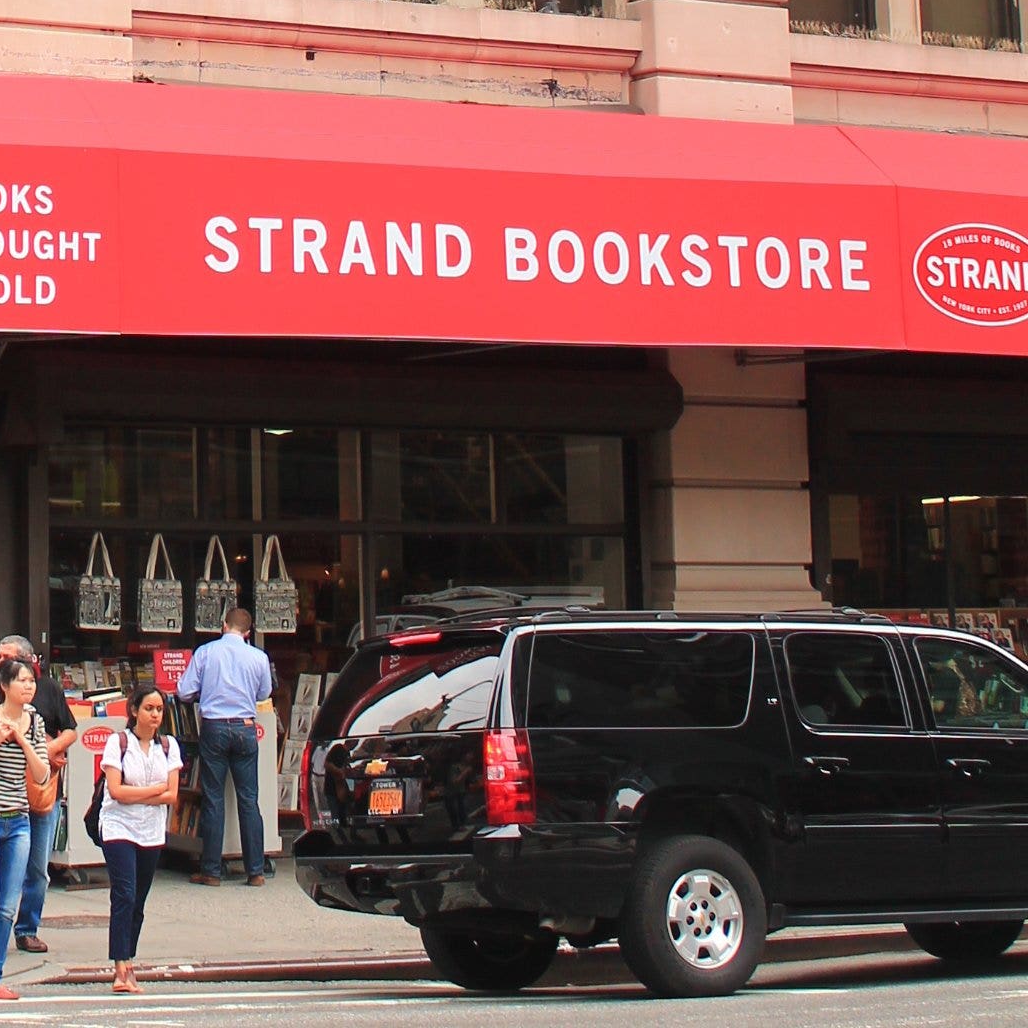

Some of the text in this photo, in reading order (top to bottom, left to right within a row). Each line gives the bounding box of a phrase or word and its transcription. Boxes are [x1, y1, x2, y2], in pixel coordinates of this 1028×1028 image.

[204, 216, 871, 292] STRAND BOOKSTORE
[954, 234, 979, 245] MILES
[981, 235, 992, 243] OF
[994, 237, 1021, 254] BOOKS
[942, 295, 957, 307] NEW
[958, 303, 975, 314] YORK
